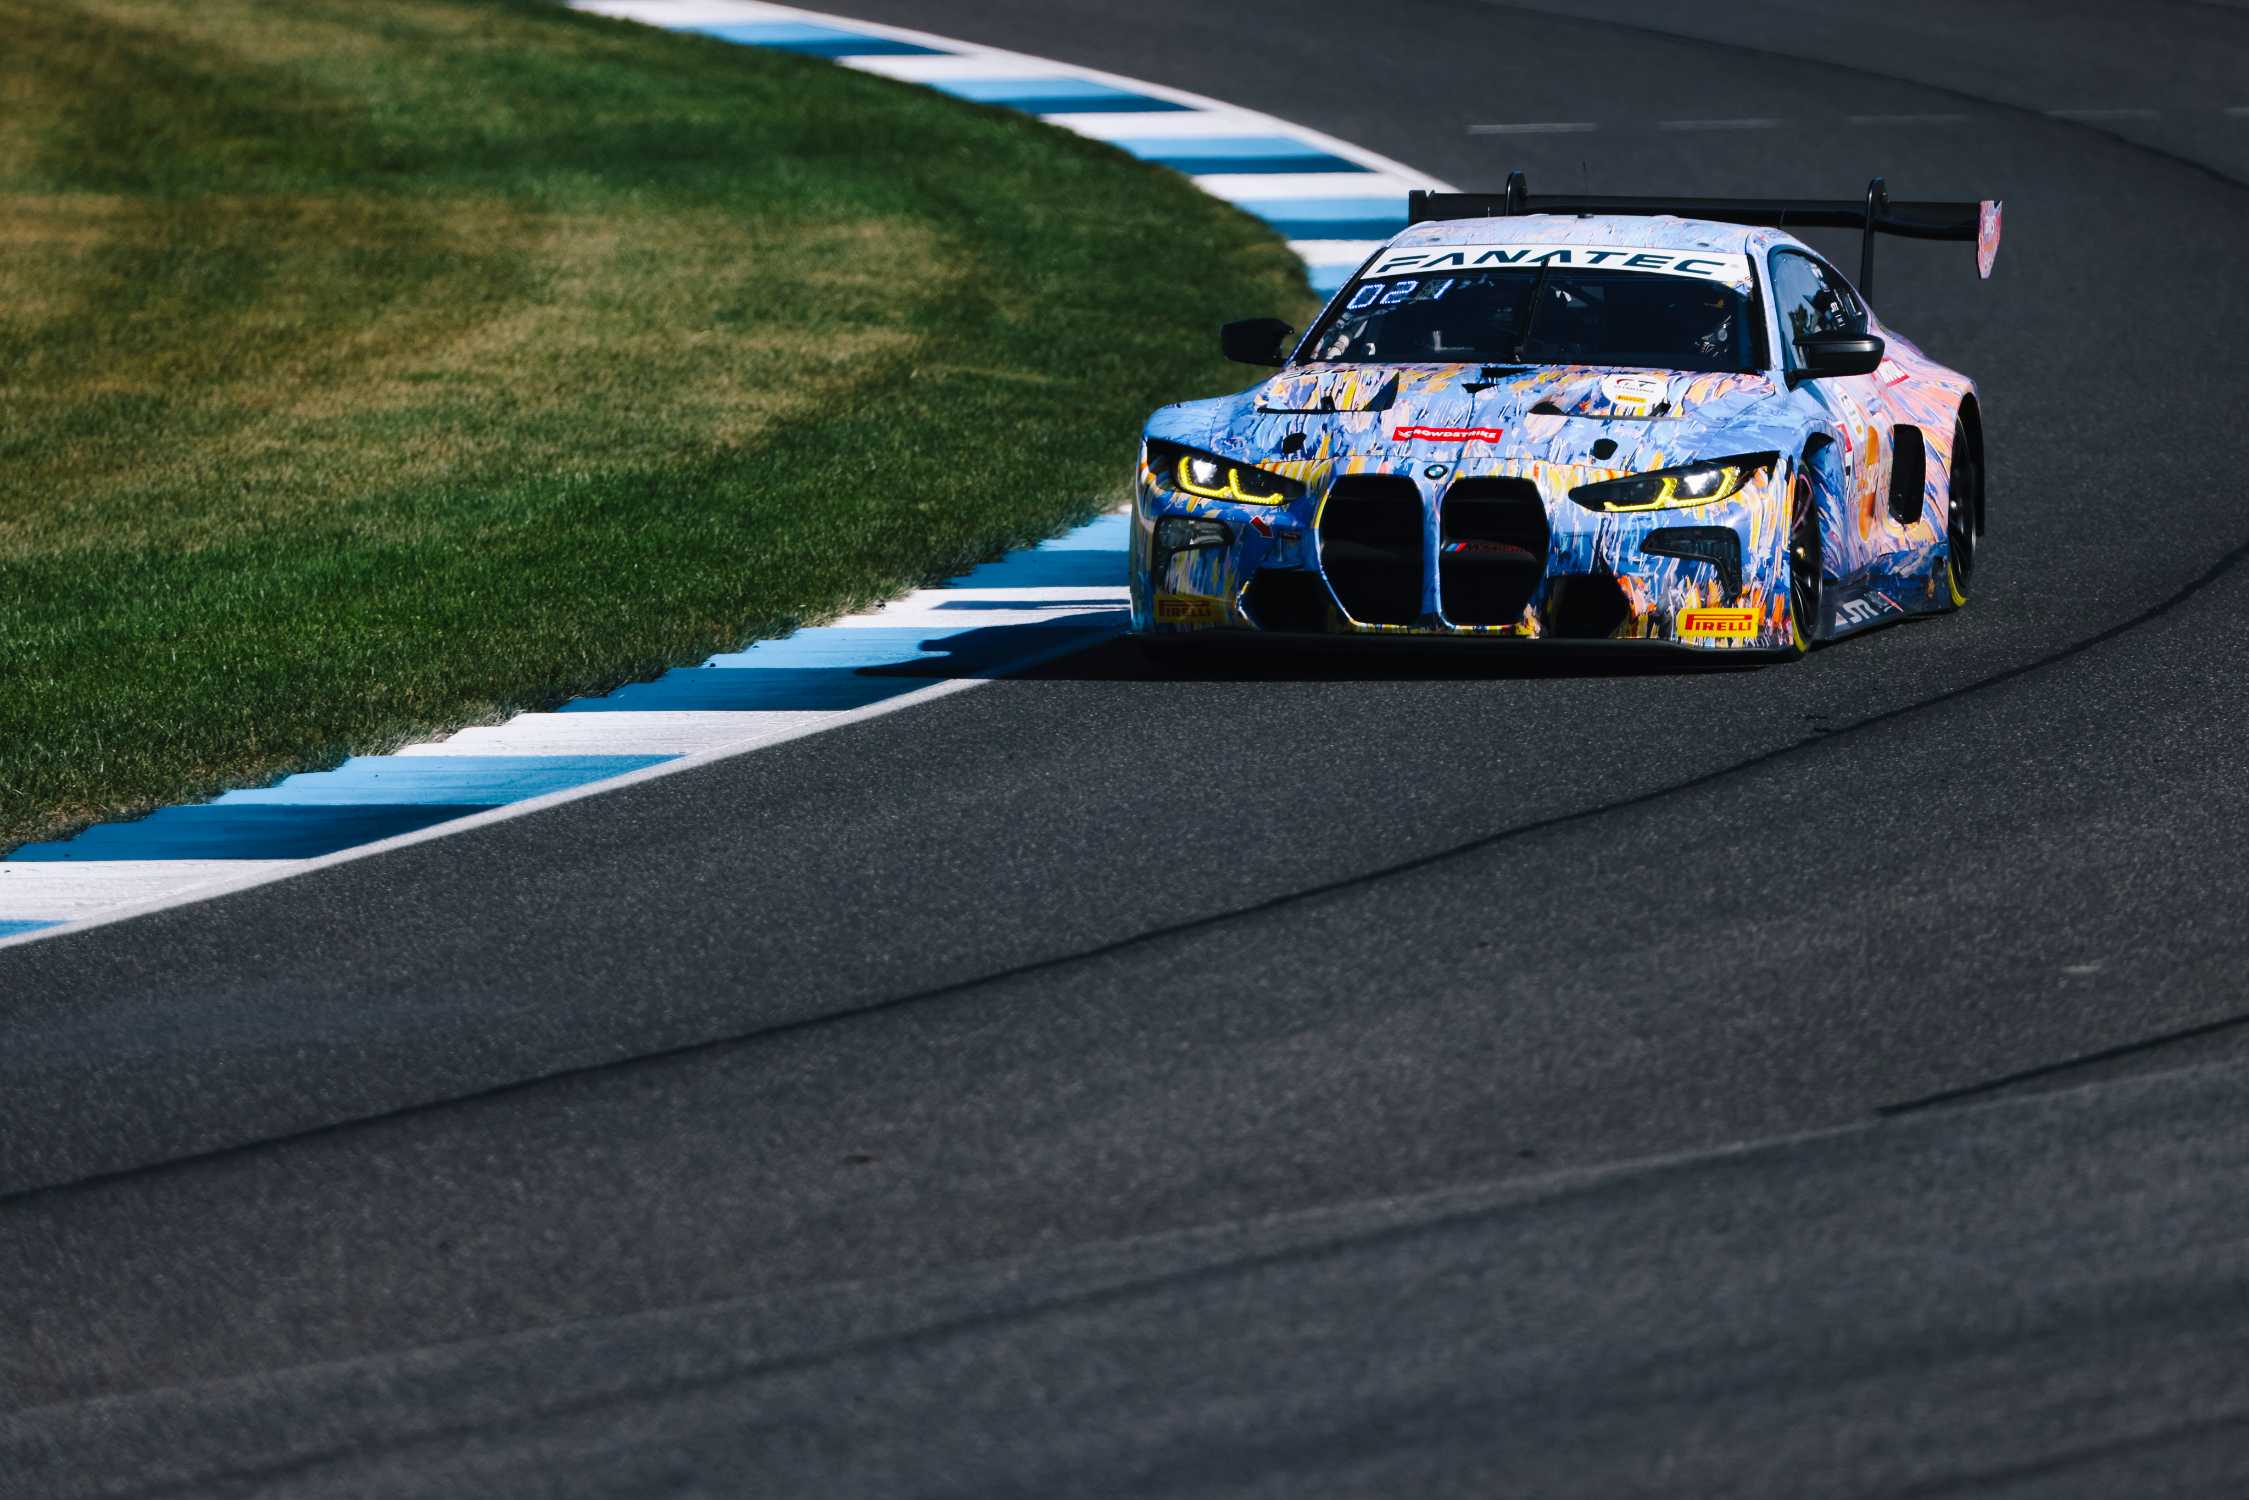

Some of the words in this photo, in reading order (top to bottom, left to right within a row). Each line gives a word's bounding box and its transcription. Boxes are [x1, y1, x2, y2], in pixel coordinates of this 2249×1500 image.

[1375, 249, 1726, 275] FANATEC
[1403, 429, 1497, 439] CROWDSTRIKE
[1685, 614, 1753, 631] PIRELLI
